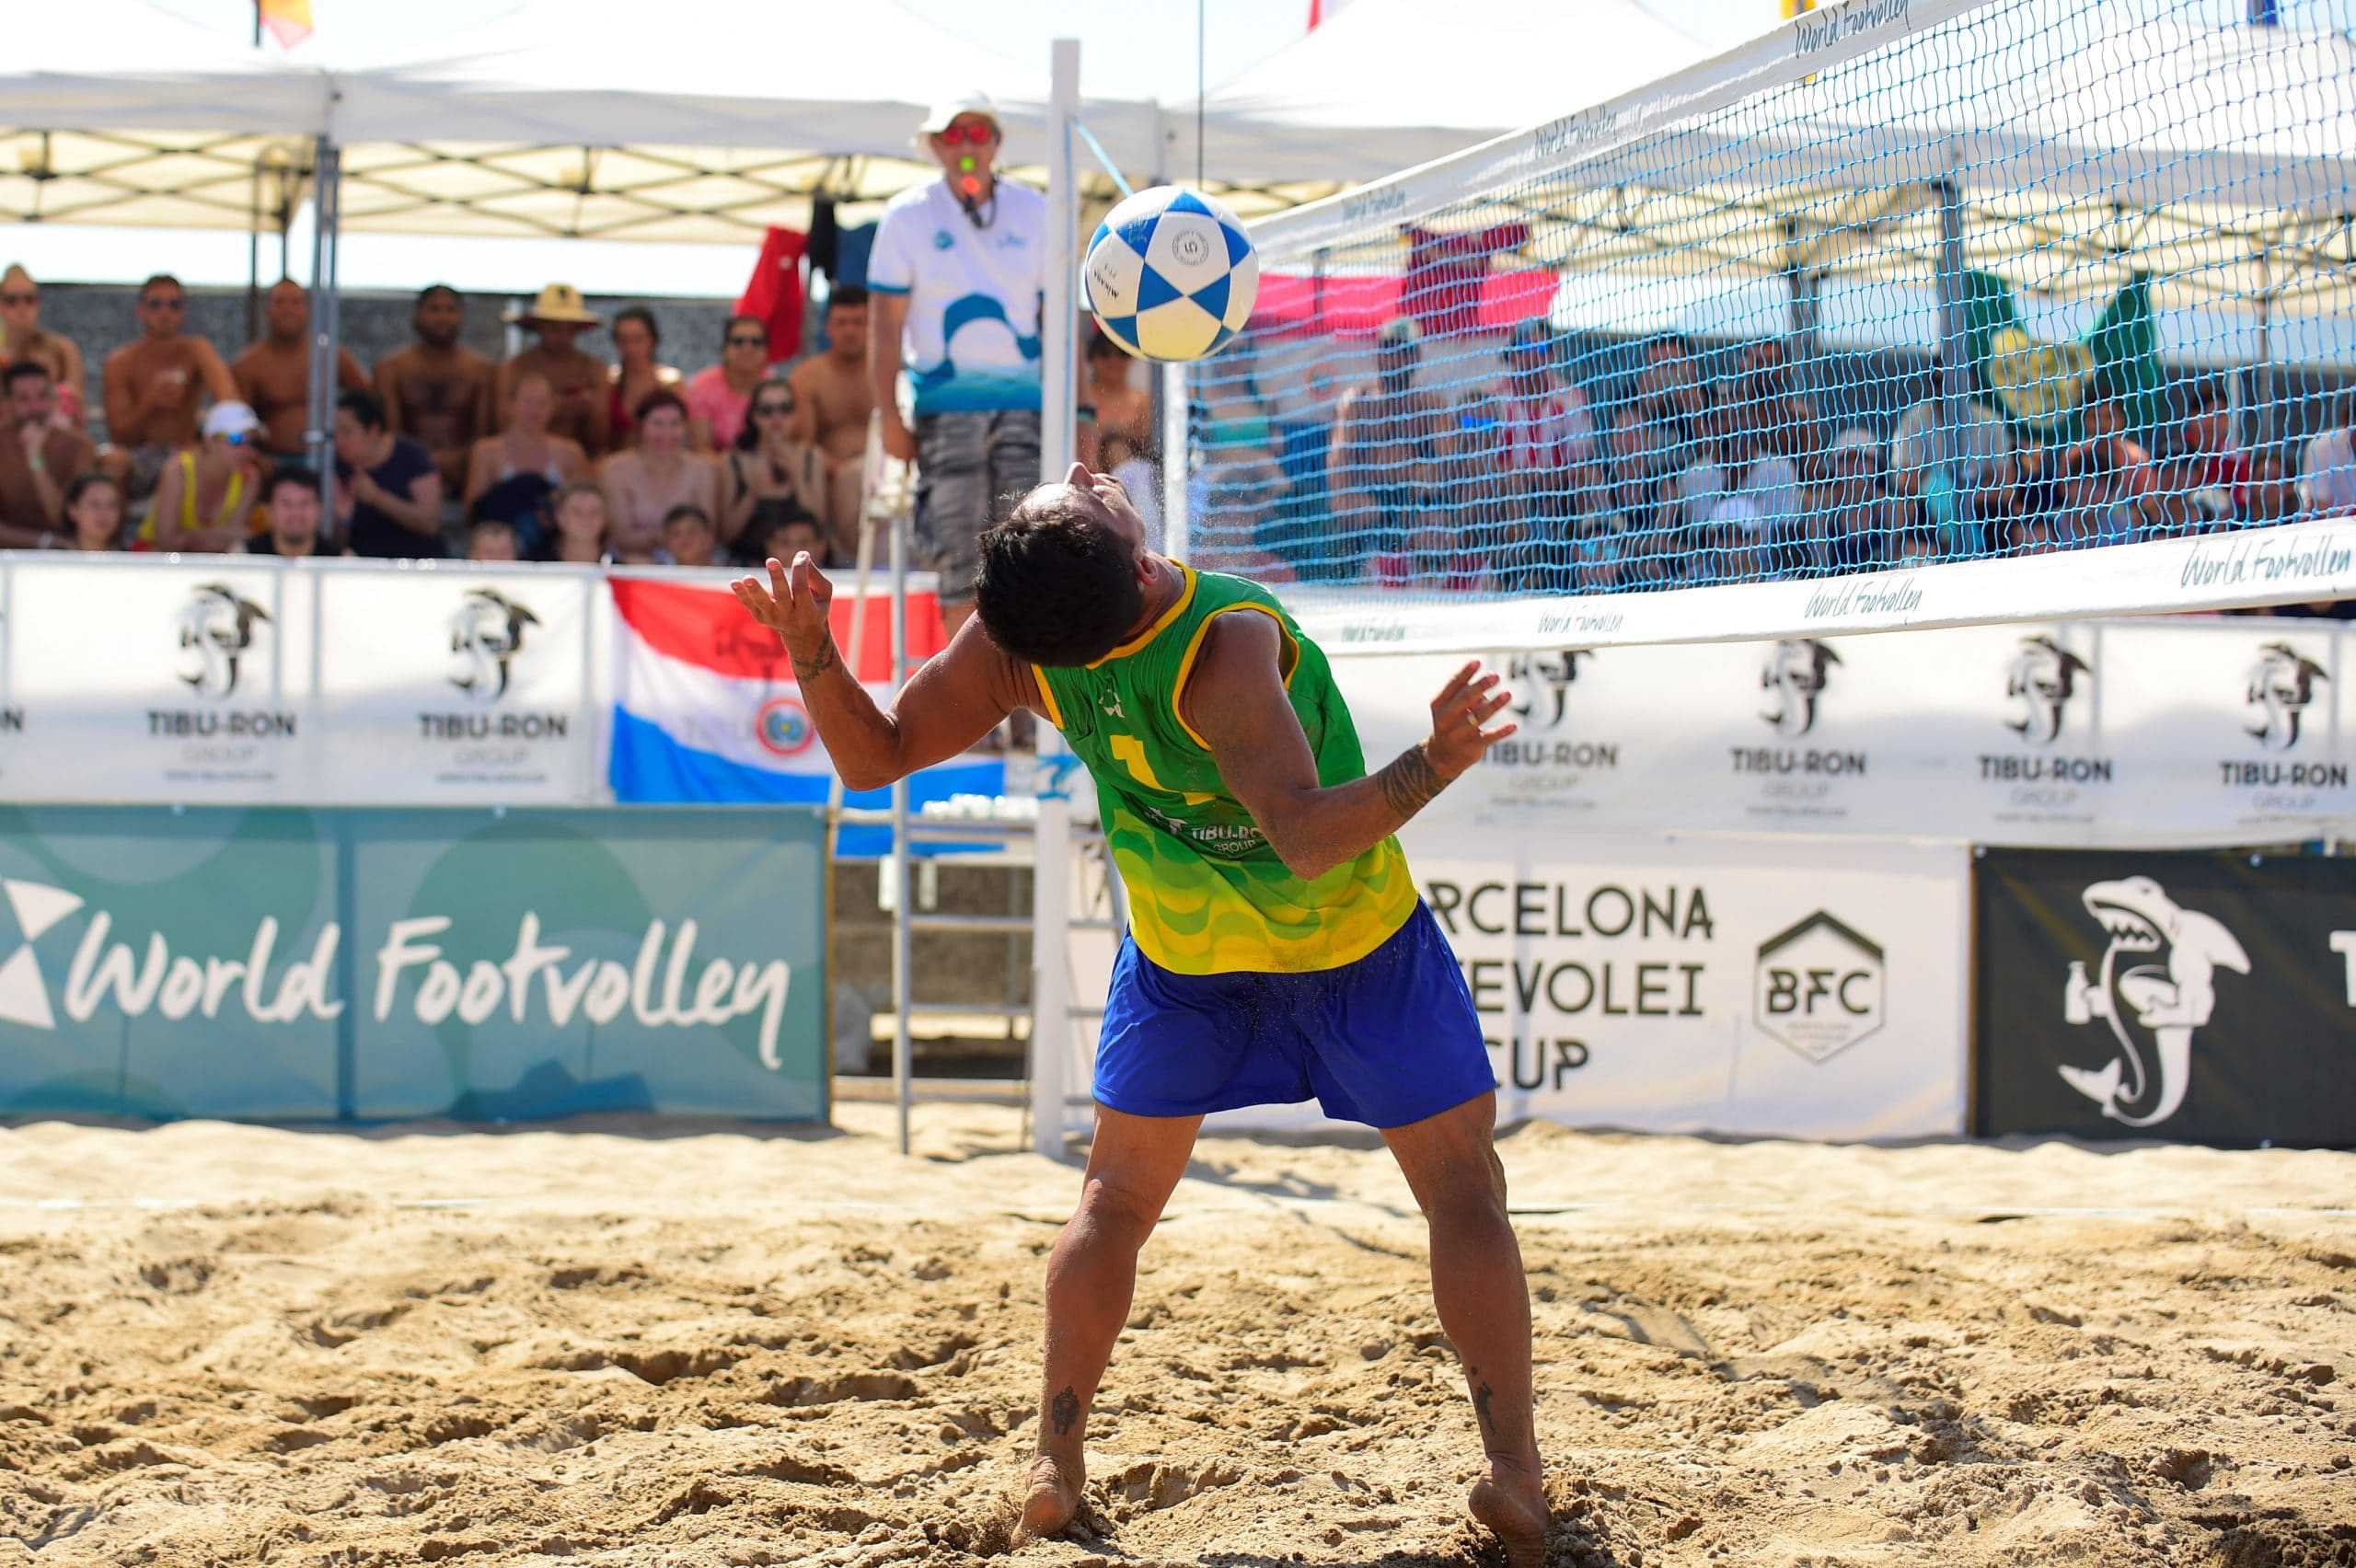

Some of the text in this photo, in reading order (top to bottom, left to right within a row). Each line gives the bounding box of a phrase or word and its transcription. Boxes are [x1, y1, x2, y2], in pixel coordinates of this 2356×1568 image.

[1795, 7, 1840, 59] World
[2181, 538, 2252, 589] World
[1805, 581, 1858, 618] World
[146, 709, 296, 737] TIBU-RON
[419, 711, 568, 740] TIBU-RON
[1730, 746, 1867, 776] TIBU-RON
[1979, 755, 2113, 783] TIBU-RON
[2219, 761, 2349, 788] TIBU-RON
[1426, 880, 1715, 940] RCELONA
[64, 910, 791, 1070] World Footvolley
[1460, 959, 1705, 1017] EVOLEI
[1768, 970, 1871, 1015] BFC
